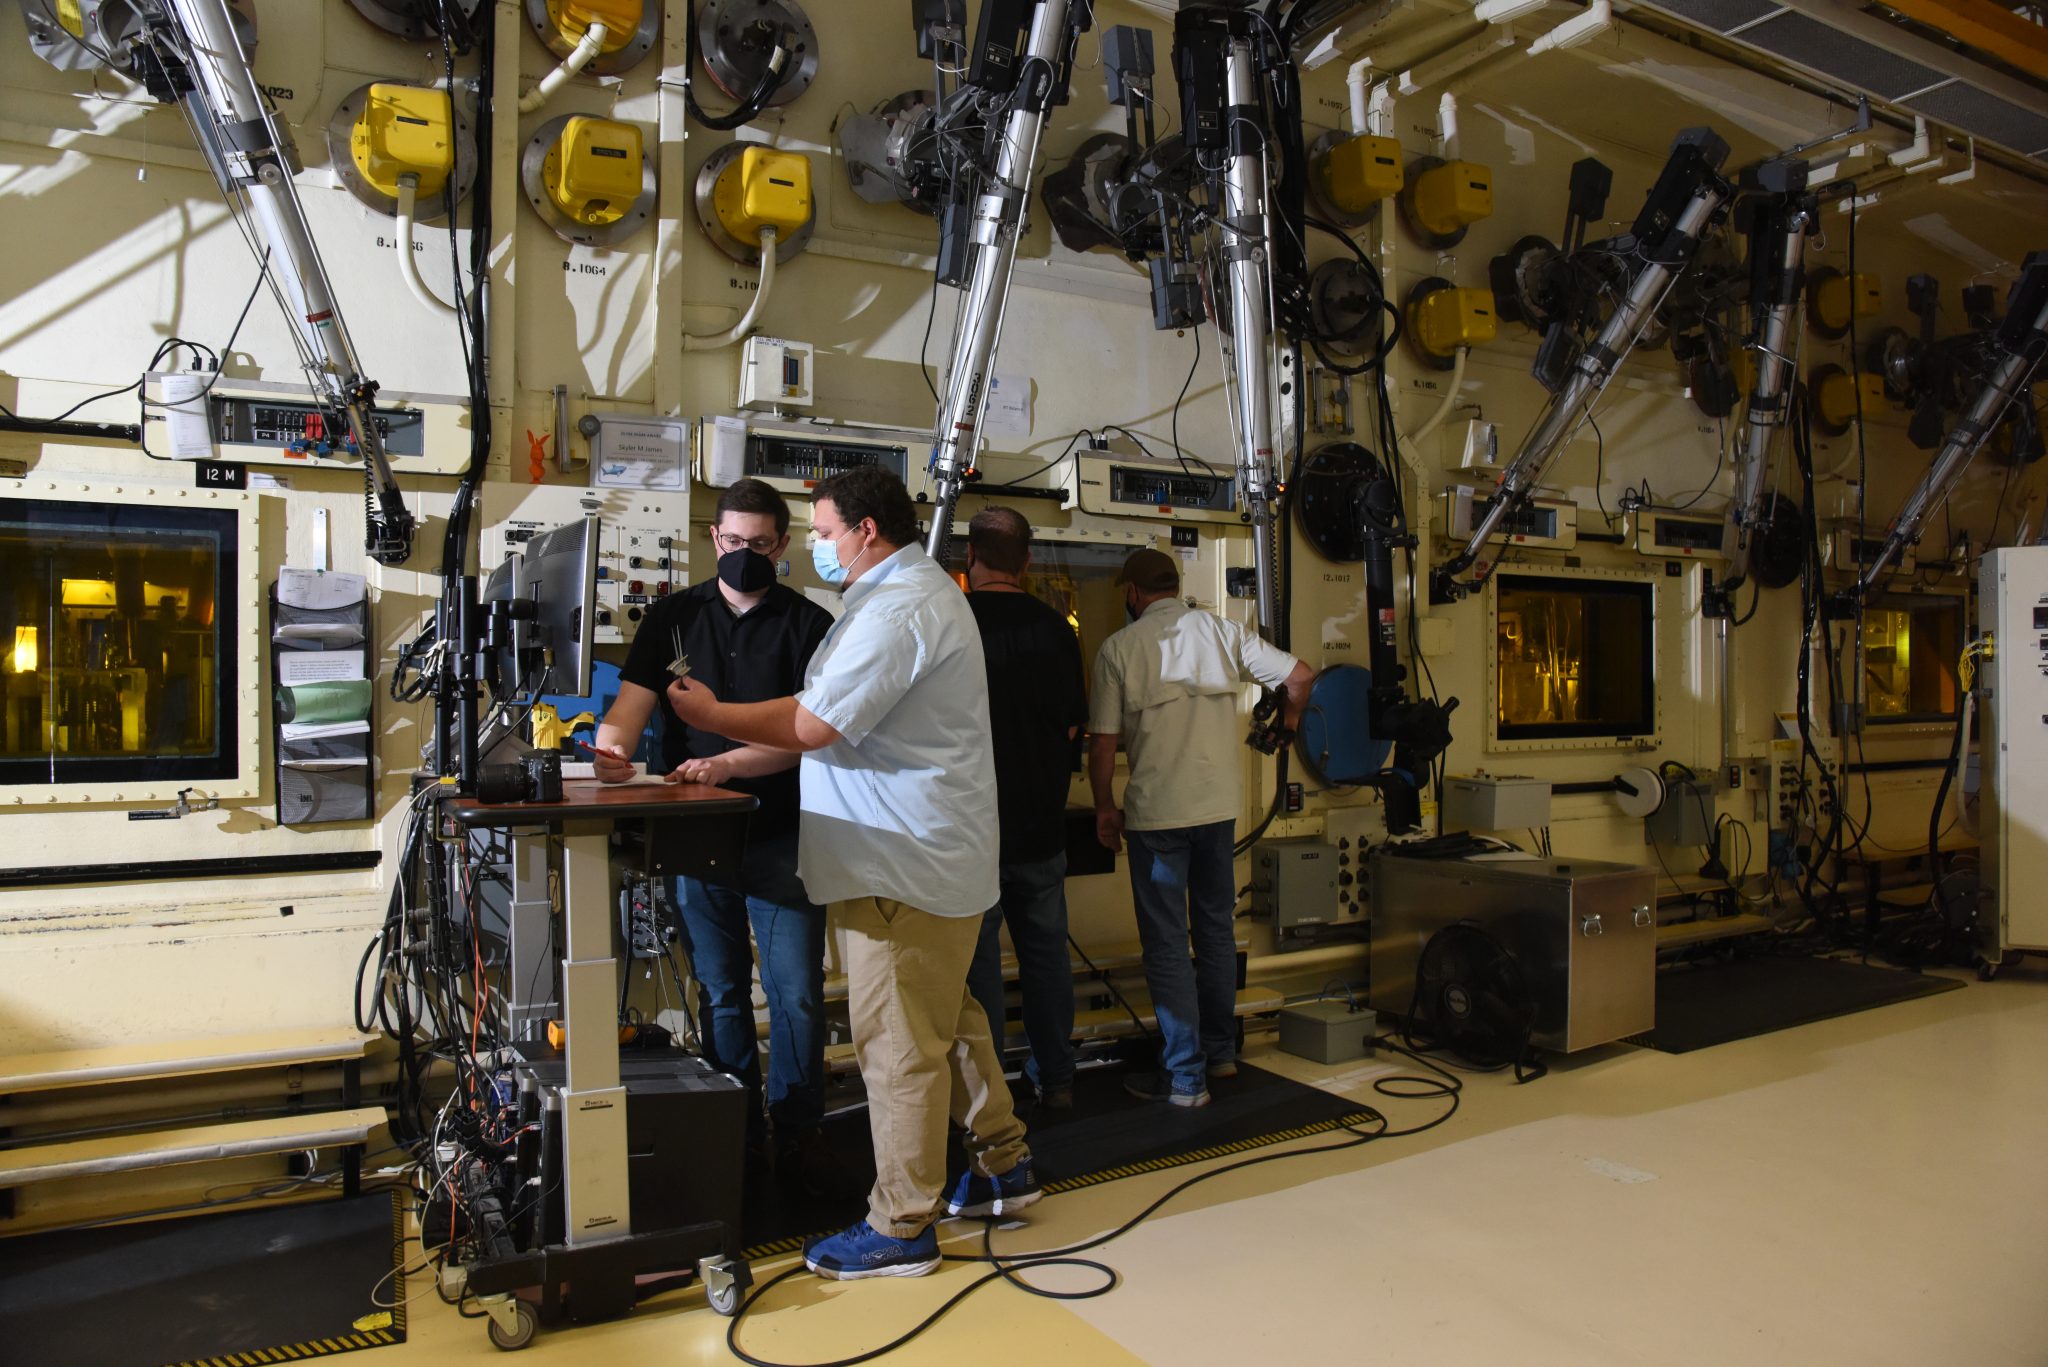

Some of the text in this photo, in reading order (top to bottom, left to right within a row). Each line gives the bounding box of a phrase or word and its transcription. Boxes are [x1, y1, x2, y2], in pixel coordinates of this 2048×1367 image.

[562, 261, 606, 276] 8.1064
[206, 468, 235, 481] 12 M
[1177, 532, 1192, 542] 11 M
[861, 1244, 904, 1265] HOKA
